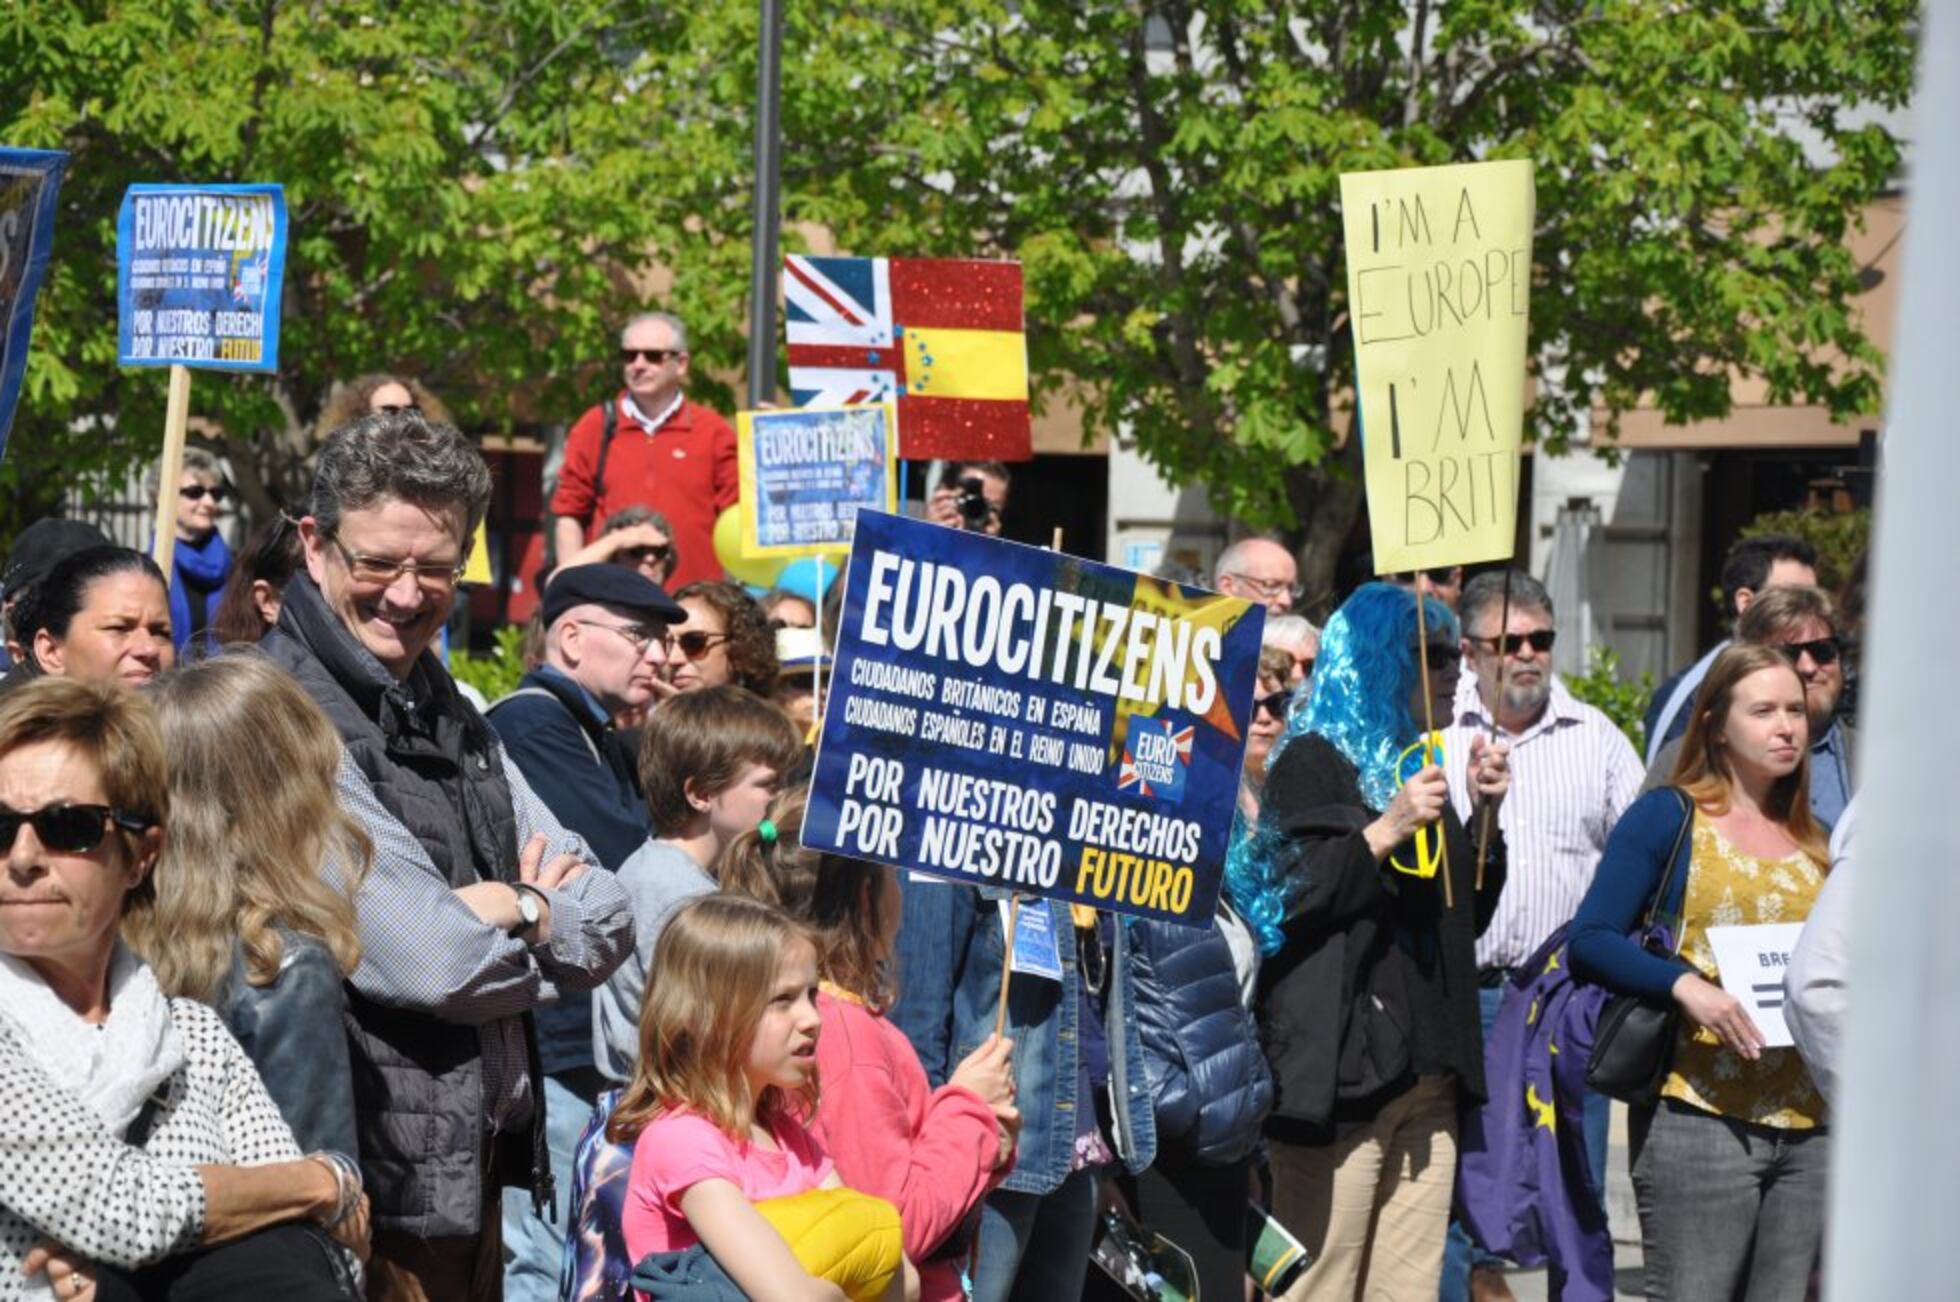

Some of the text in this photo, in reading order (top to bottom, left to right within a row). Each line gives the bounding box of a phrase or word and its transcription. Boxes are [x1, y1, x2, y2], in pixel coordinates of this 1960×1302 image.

[1372, 186, 1480, 254] I'M A
[1389, 359, 1494, 459] I'M
[861, 550, 1221, 715] EUROCITIZENS
[845, 695, 1105, 776] CIUDADANOS ESPAÑOLES EN EL REINO UNIDO
[851, 657, 1101, 736] CIUDADANOS BRITÁNICOS EN ESPAÑA
[1135, 761, 1175, 785] CITIZENS
[1136, 731, 1178, 766] EURO
[845, 752, 1201, 863] POR NUESTROS DERECHOS
[835, 800, 1194, 914] POR NUESTRO FUTURO
